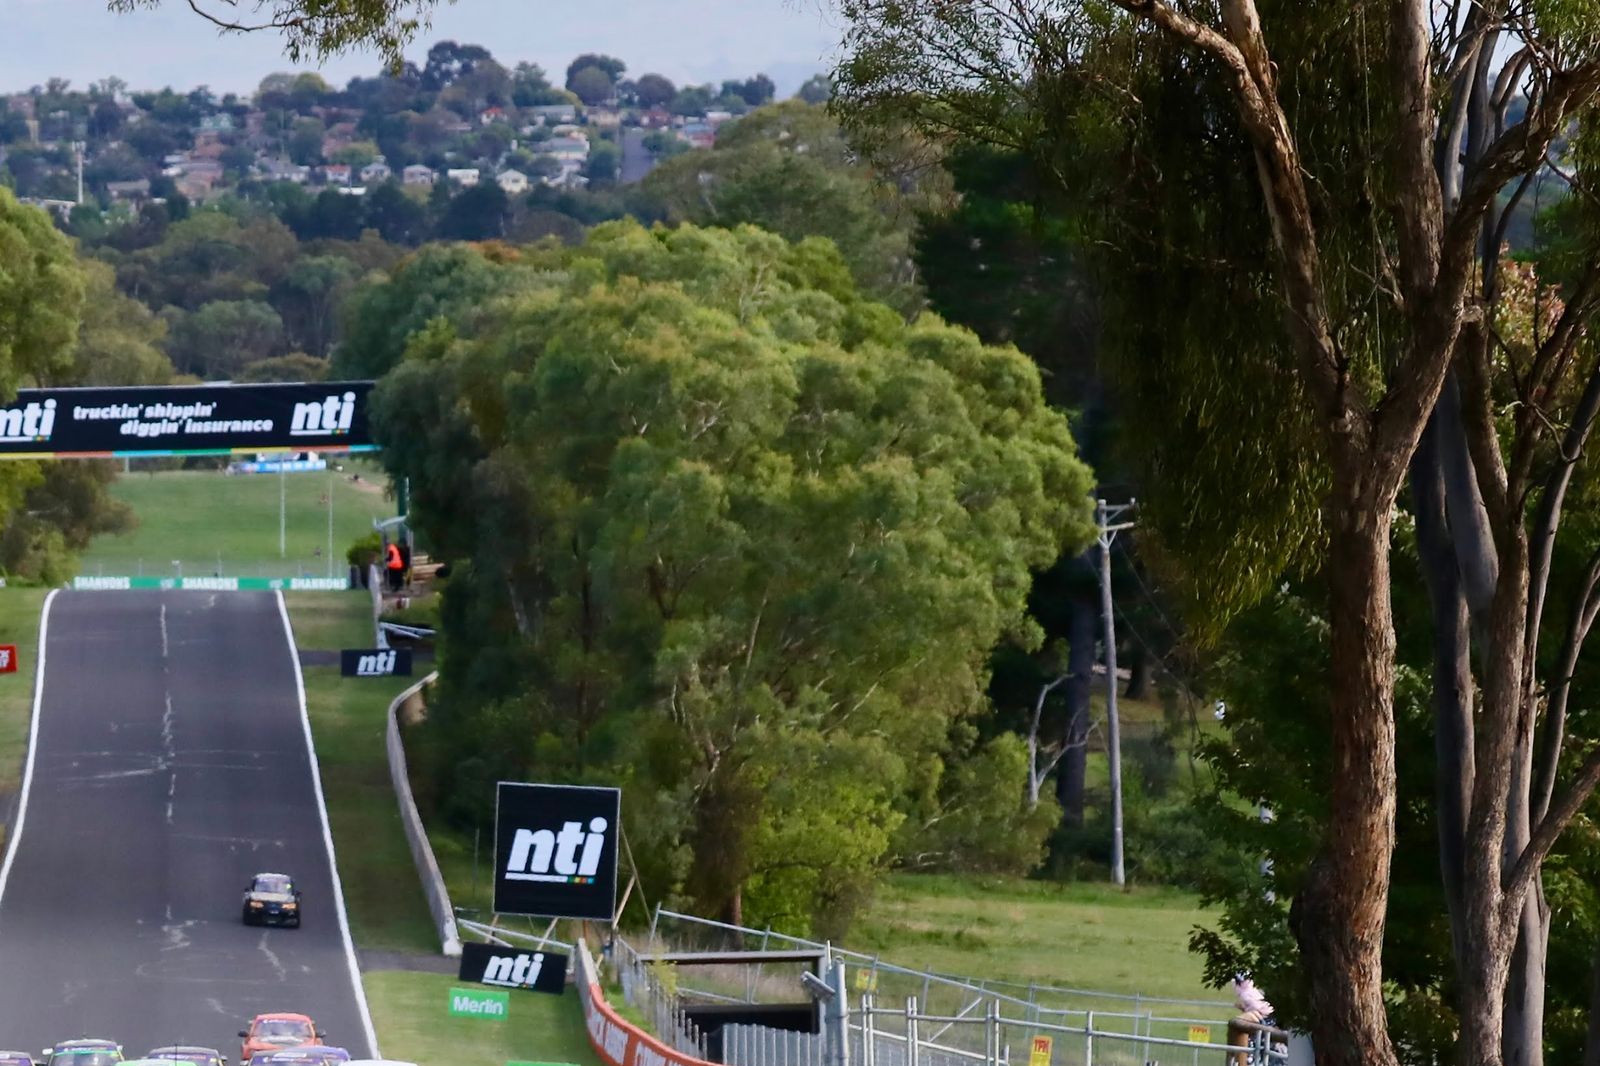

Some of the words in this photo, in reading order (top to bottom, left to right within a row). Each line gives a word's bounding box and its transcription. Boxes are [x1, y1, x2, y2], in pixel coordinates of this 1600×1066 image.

[73, 404, 144, 420] truckin'
[144, 402, 217, 420] shippin'
[290, 391, 356, 431] nti
[119, 419, 183, 438] diggin'
[184, 419, 274, 434] insurance
[74, 576, 131, 590] SHANNONS
[182, 576, 239, 590] SHANNONS
[291, 576, 348, 590] SHANNONS
[357, 649, 397, 673] nti
[506, 816, 608, 877] nti
[483, 953, 545, 985] nti
[454, 996, 504, 1015] Merlin
